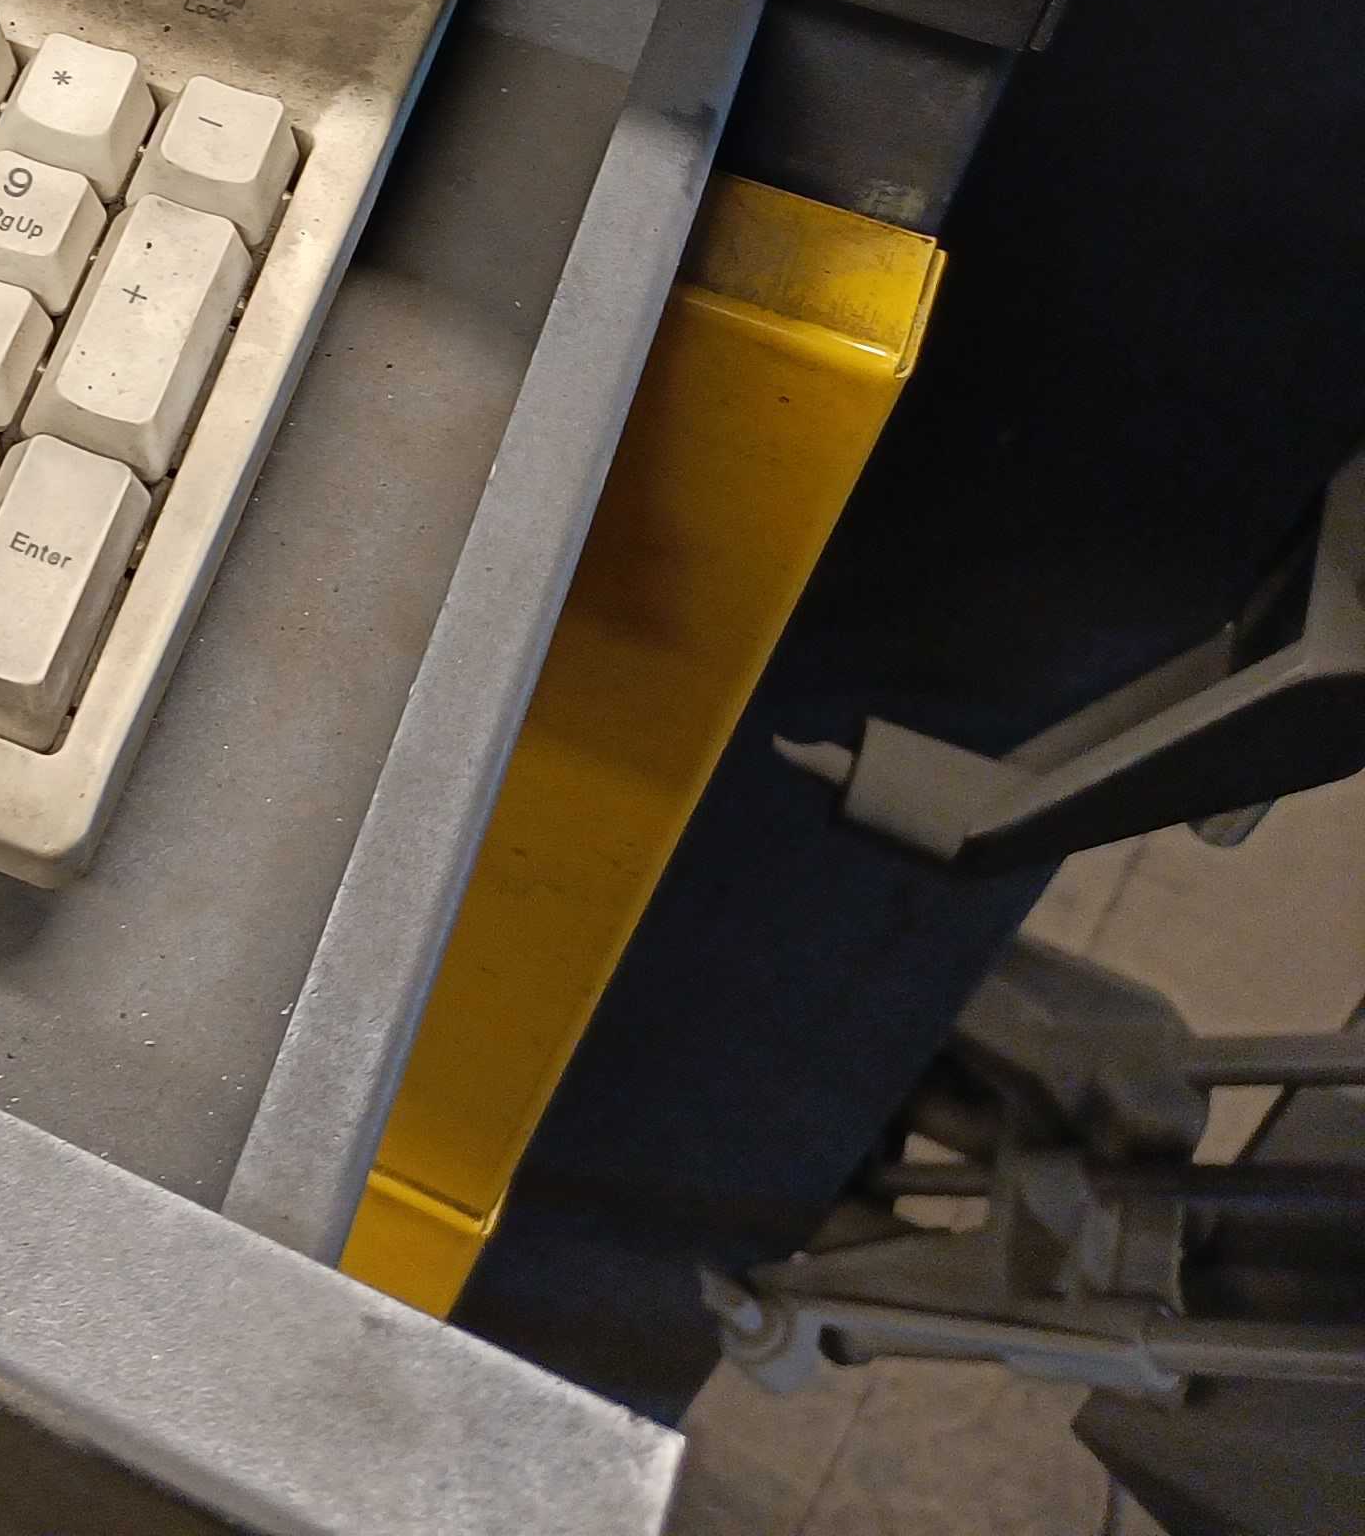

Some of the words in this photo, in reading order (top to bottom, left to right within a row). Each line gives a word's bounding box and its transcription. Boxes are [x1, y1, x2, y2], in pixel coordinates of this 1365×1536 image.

[3, 167, 33, 197] 9
[122, 284, 148, 304] +
[9, 530, 73, 569] Enter
